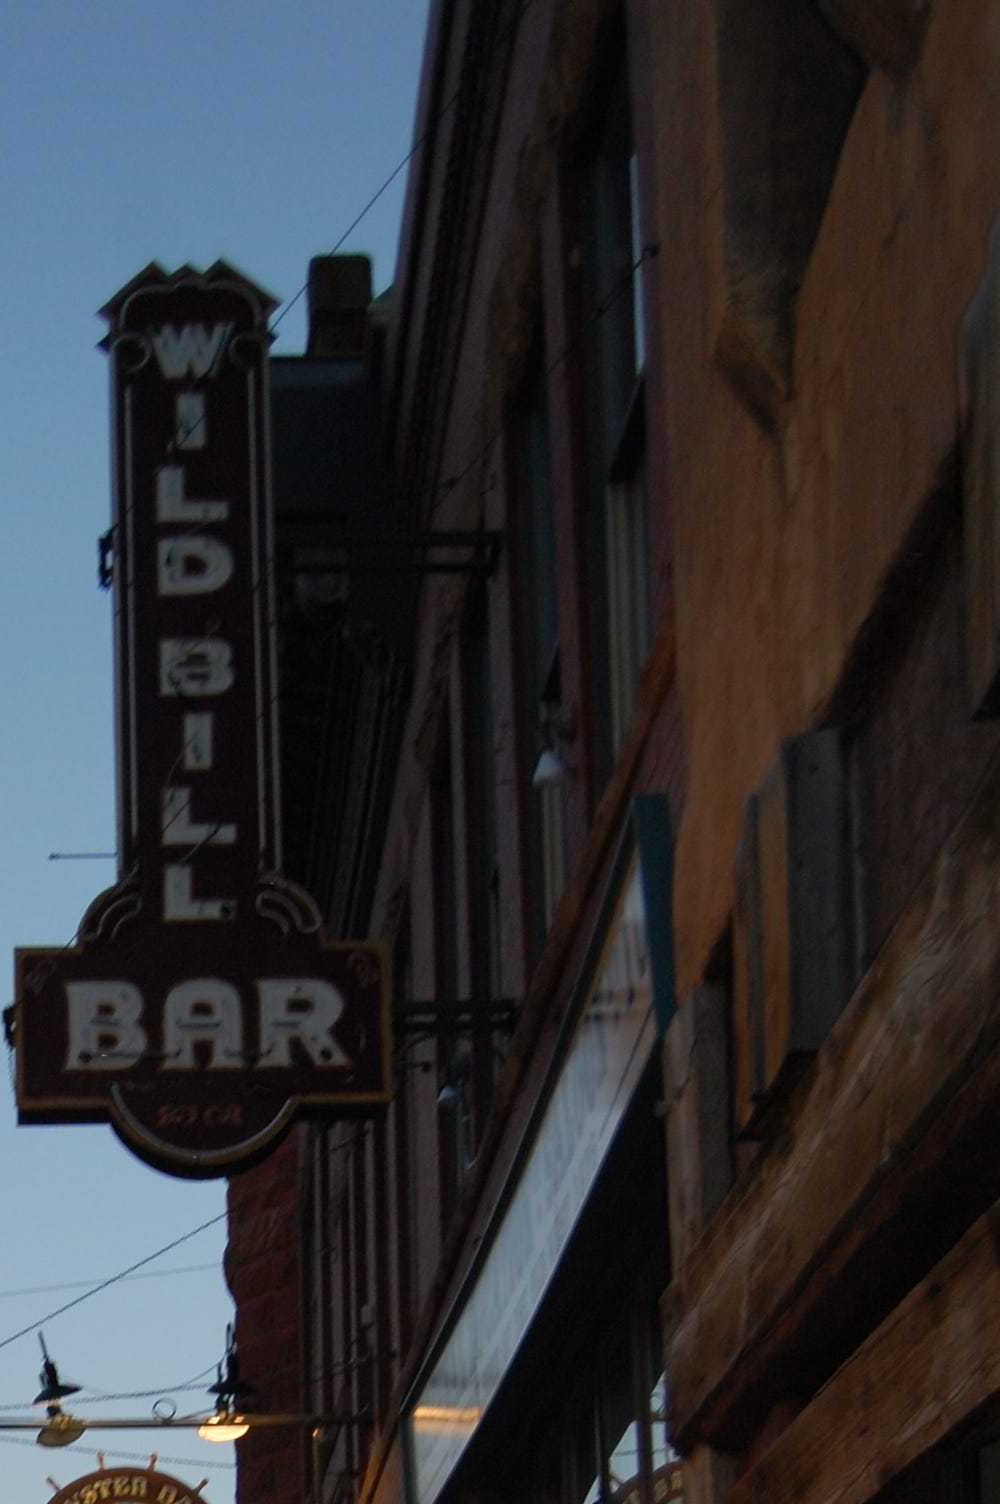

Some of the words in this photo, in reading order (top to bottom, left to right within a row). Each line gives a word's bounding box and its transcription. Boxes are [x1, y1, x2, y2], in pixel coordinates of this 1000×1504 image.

[151, 322, 235, 598] WILD
[157, 636, 237, 922] BILL
[63, 976, 352, 1072] BAR
